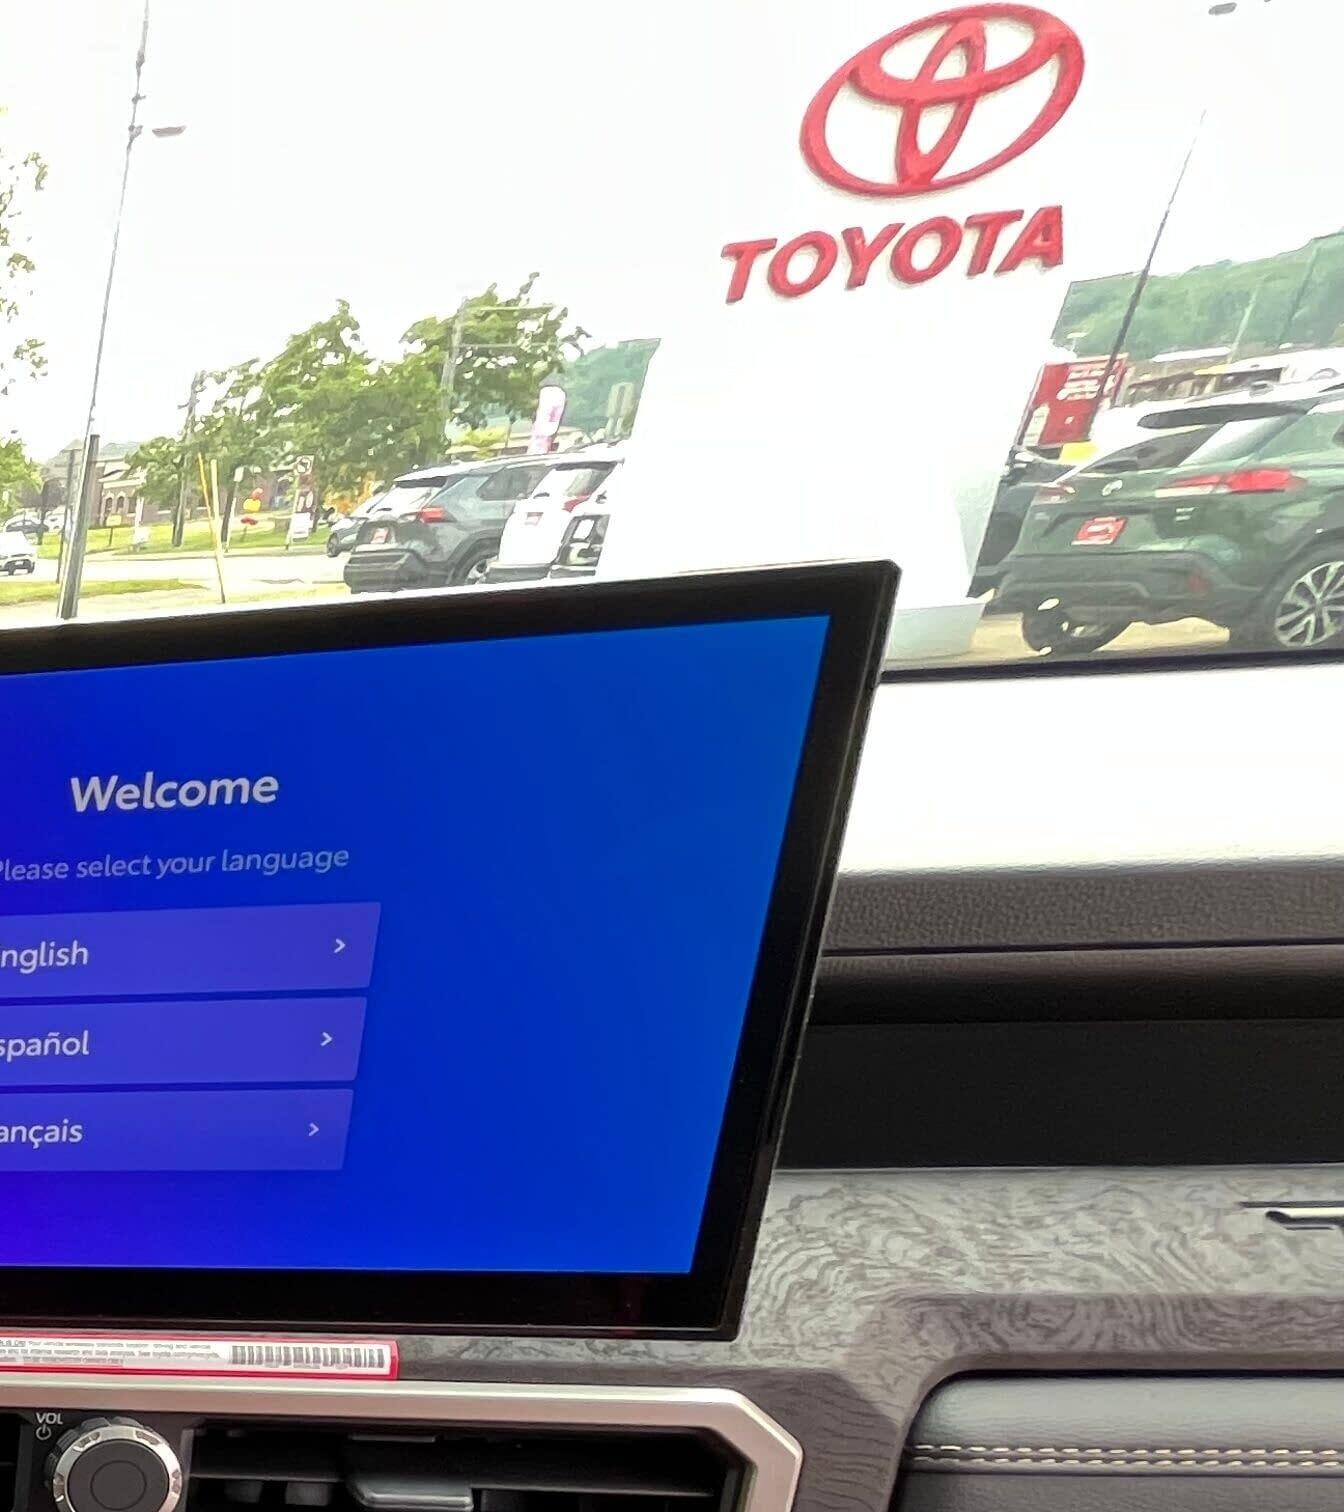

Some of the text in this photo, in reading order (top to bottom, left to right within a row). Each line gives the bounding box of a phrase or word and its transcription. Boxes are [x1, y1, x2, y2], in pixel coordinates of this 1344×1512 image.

[720, 205, 1064, 304] TOYOTA
[71, 771, 279, 813] Welcome
[76, 855, 151, 878] select
[156, 852, 215, 880] your
[221, 848, 350, 876] language
[35, 1412, 63, 1425] VOL
